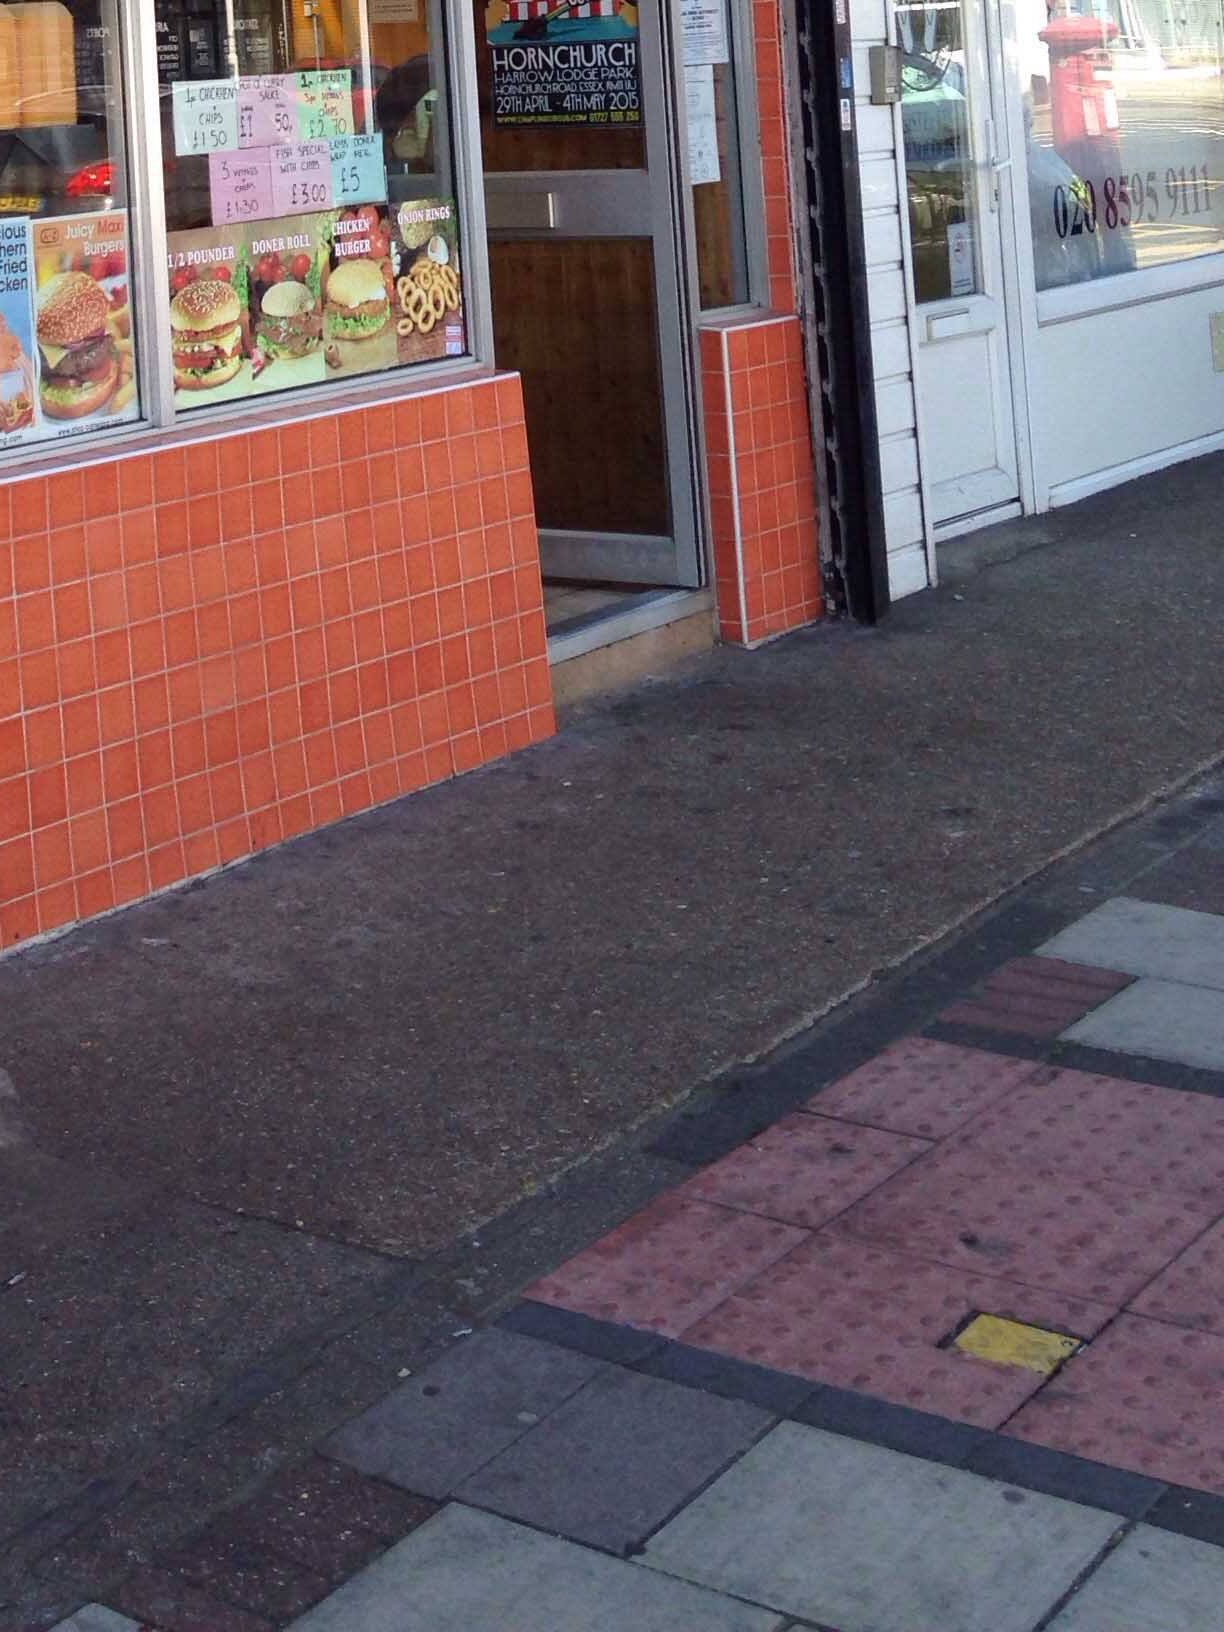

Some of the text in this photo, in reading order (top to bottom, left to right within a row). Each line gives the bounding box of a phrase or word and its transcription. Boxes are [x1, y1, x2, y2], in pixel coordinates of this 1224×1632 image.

[492, 43, 636, 71] HORNCHURCH
[495, 71, 554, 84] HARROW
[557, 69, 599, 82] LODGE
[199, 88, 235, 101] CHICKEN
[495, 83, 552, 96] HORNCHURCH
[496, 96, 523, 114] 29TH
[525, 95, 552, 113] APRIL
[562, 94, 582, 111] 4TH
[584, 94, 605, 111] MAY
[609, 92, 639, 110] 2015
[199, 112, 224, 126] CHIPS
[297, 145, 328, 157] SPECIAL
[341, 167, 360, 193] £5
[1103, 171, 1160, 230] 8595
[1165, 163, 1212, 219] 9111
[397, 205, 451, 226] ONION RINGS
[64, 223, 95, 240] Juicy
[331, 218, 370, 236] CHICKEN
[252, 234, 312, 255] DONER ROLL
[334, 238, 372, 257] BURGER
[167, 246, 235, 268] 1/2 POUNDER
